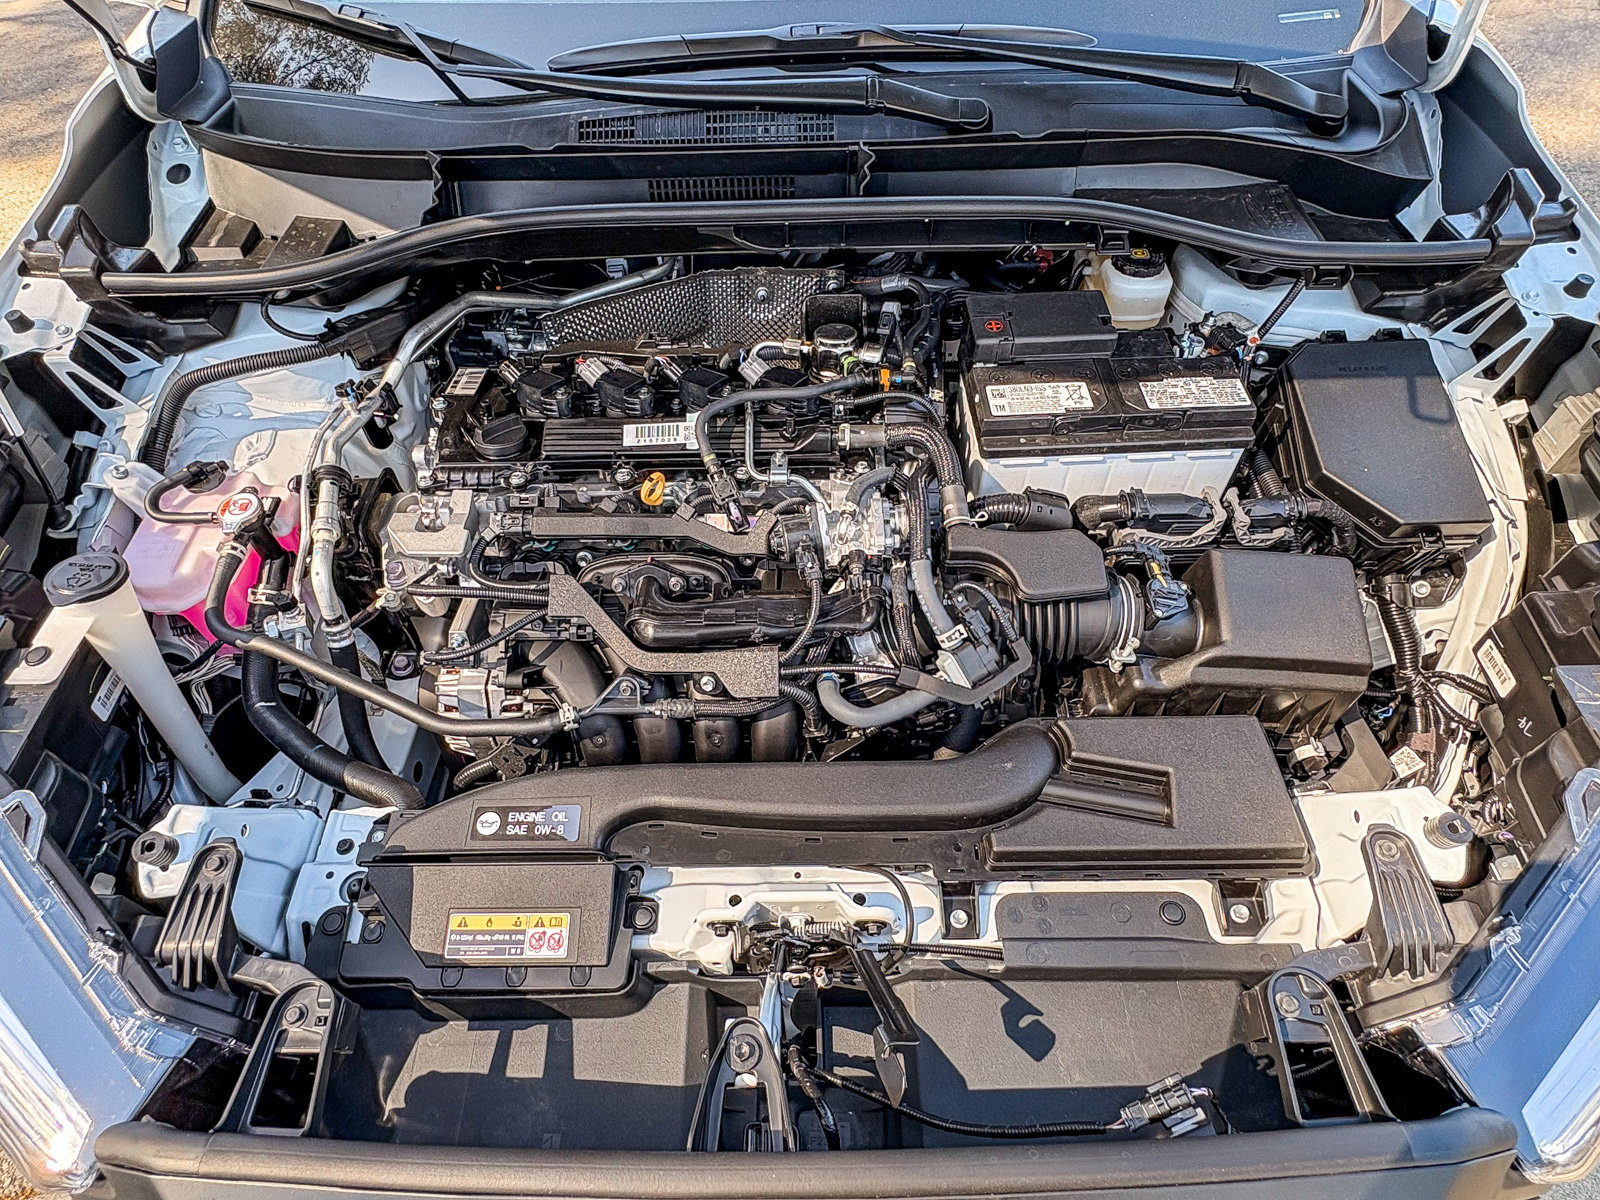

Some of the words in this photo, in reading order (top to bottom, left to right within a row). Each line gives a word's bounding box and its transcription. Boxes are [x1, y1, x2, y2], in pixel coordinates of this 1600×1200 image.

[994, 404, 1006, 412] TM
[507, 811, 547, 822] ENGINE
[551, 811, 569, 822] OIL
[505, 824, 528, 835] SAE
[534, 824, 564, 835] 0W-8
